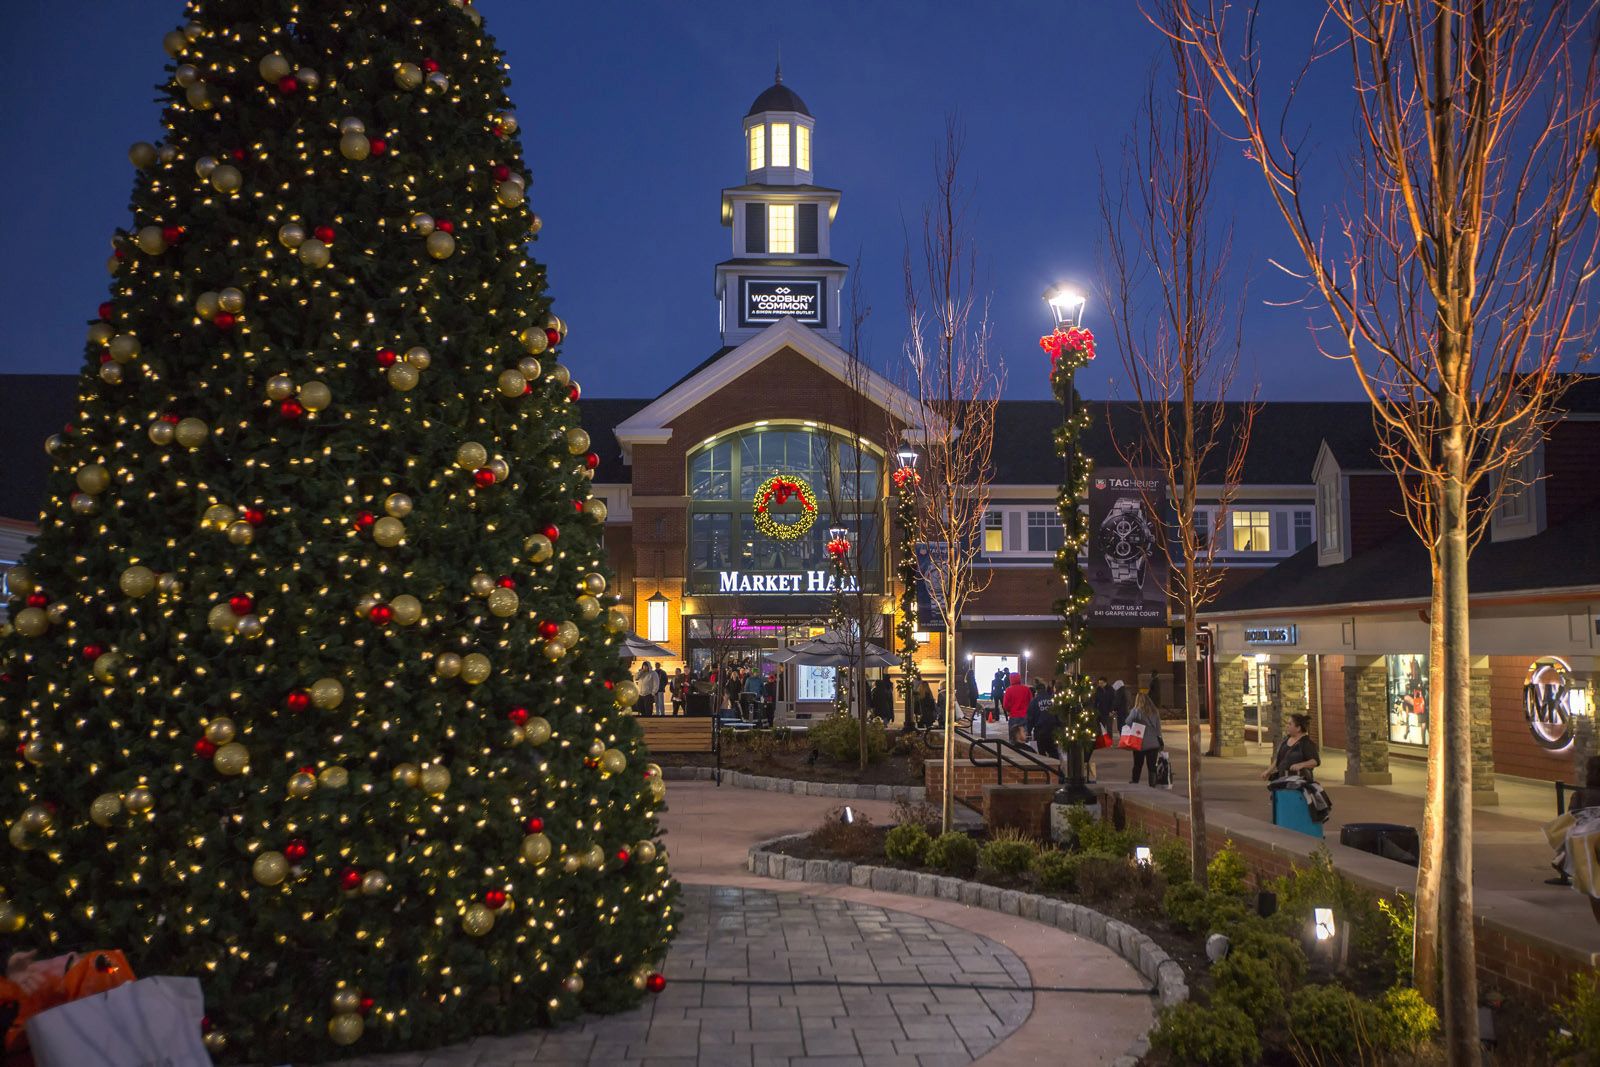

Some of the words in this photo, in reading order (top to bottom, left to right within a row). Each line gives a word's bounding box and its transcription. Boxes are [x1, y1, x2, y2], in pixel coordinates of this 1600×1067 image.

[751, 294, 815, 303] WOODBURY
[758, 302, 809, 310] COMMON
[720, 571, 802, 592] MARKET
[1523, 684, 1571, 724] MK
